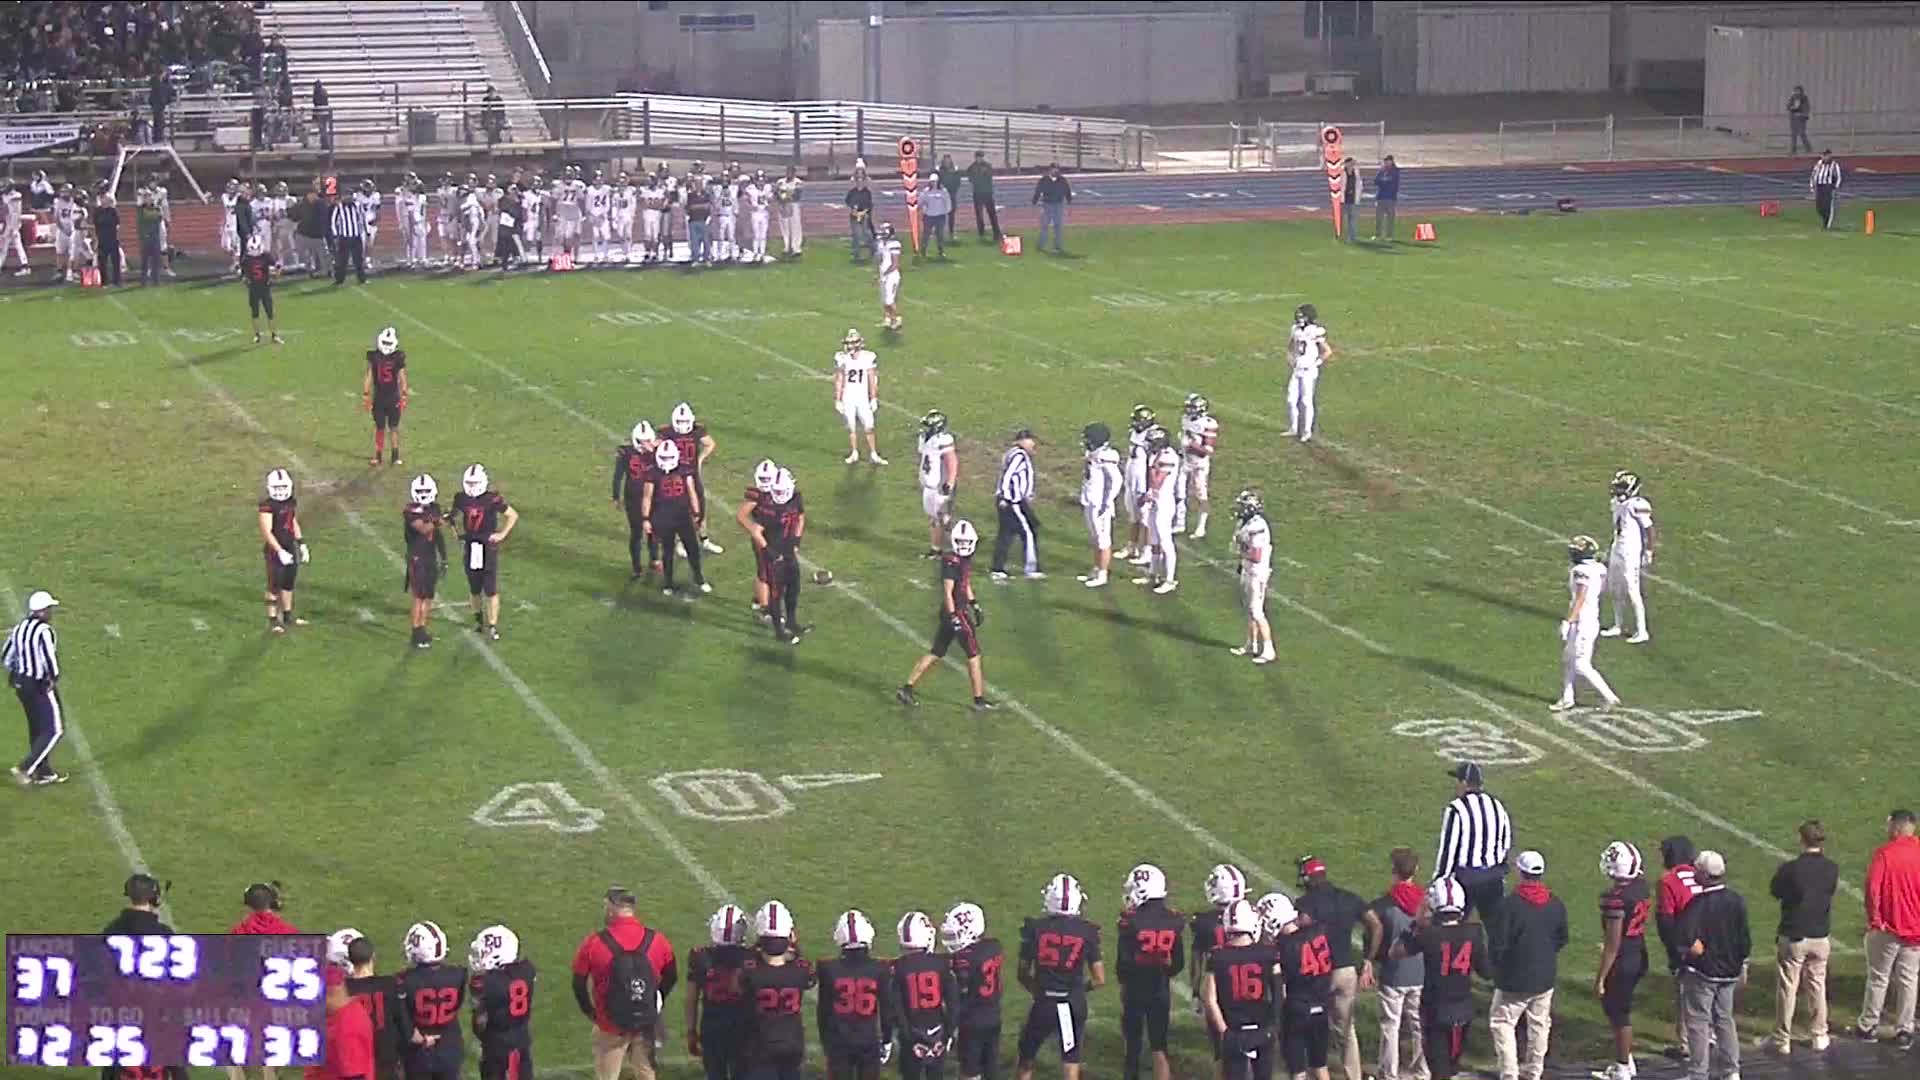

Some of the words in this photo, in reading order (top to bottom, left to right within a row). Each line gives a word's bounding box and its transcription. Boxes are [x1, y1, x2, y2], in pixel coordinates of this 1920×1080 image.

[325, 177, 337, 195] 2
[848, 368, 863, 384] 21
[1392, 707, 1710, 765] 30
[469, 767, 796, 832] 40
[1301, 935, 1332, 976] 42
[1440, 940, 1473, 977] 14
[508, 978, 529, 1018] 8
[833, 976, 878, 1017] 36
[906, 971, 942, 1009] 19
[1230, 963, 1264, 1001] 16
